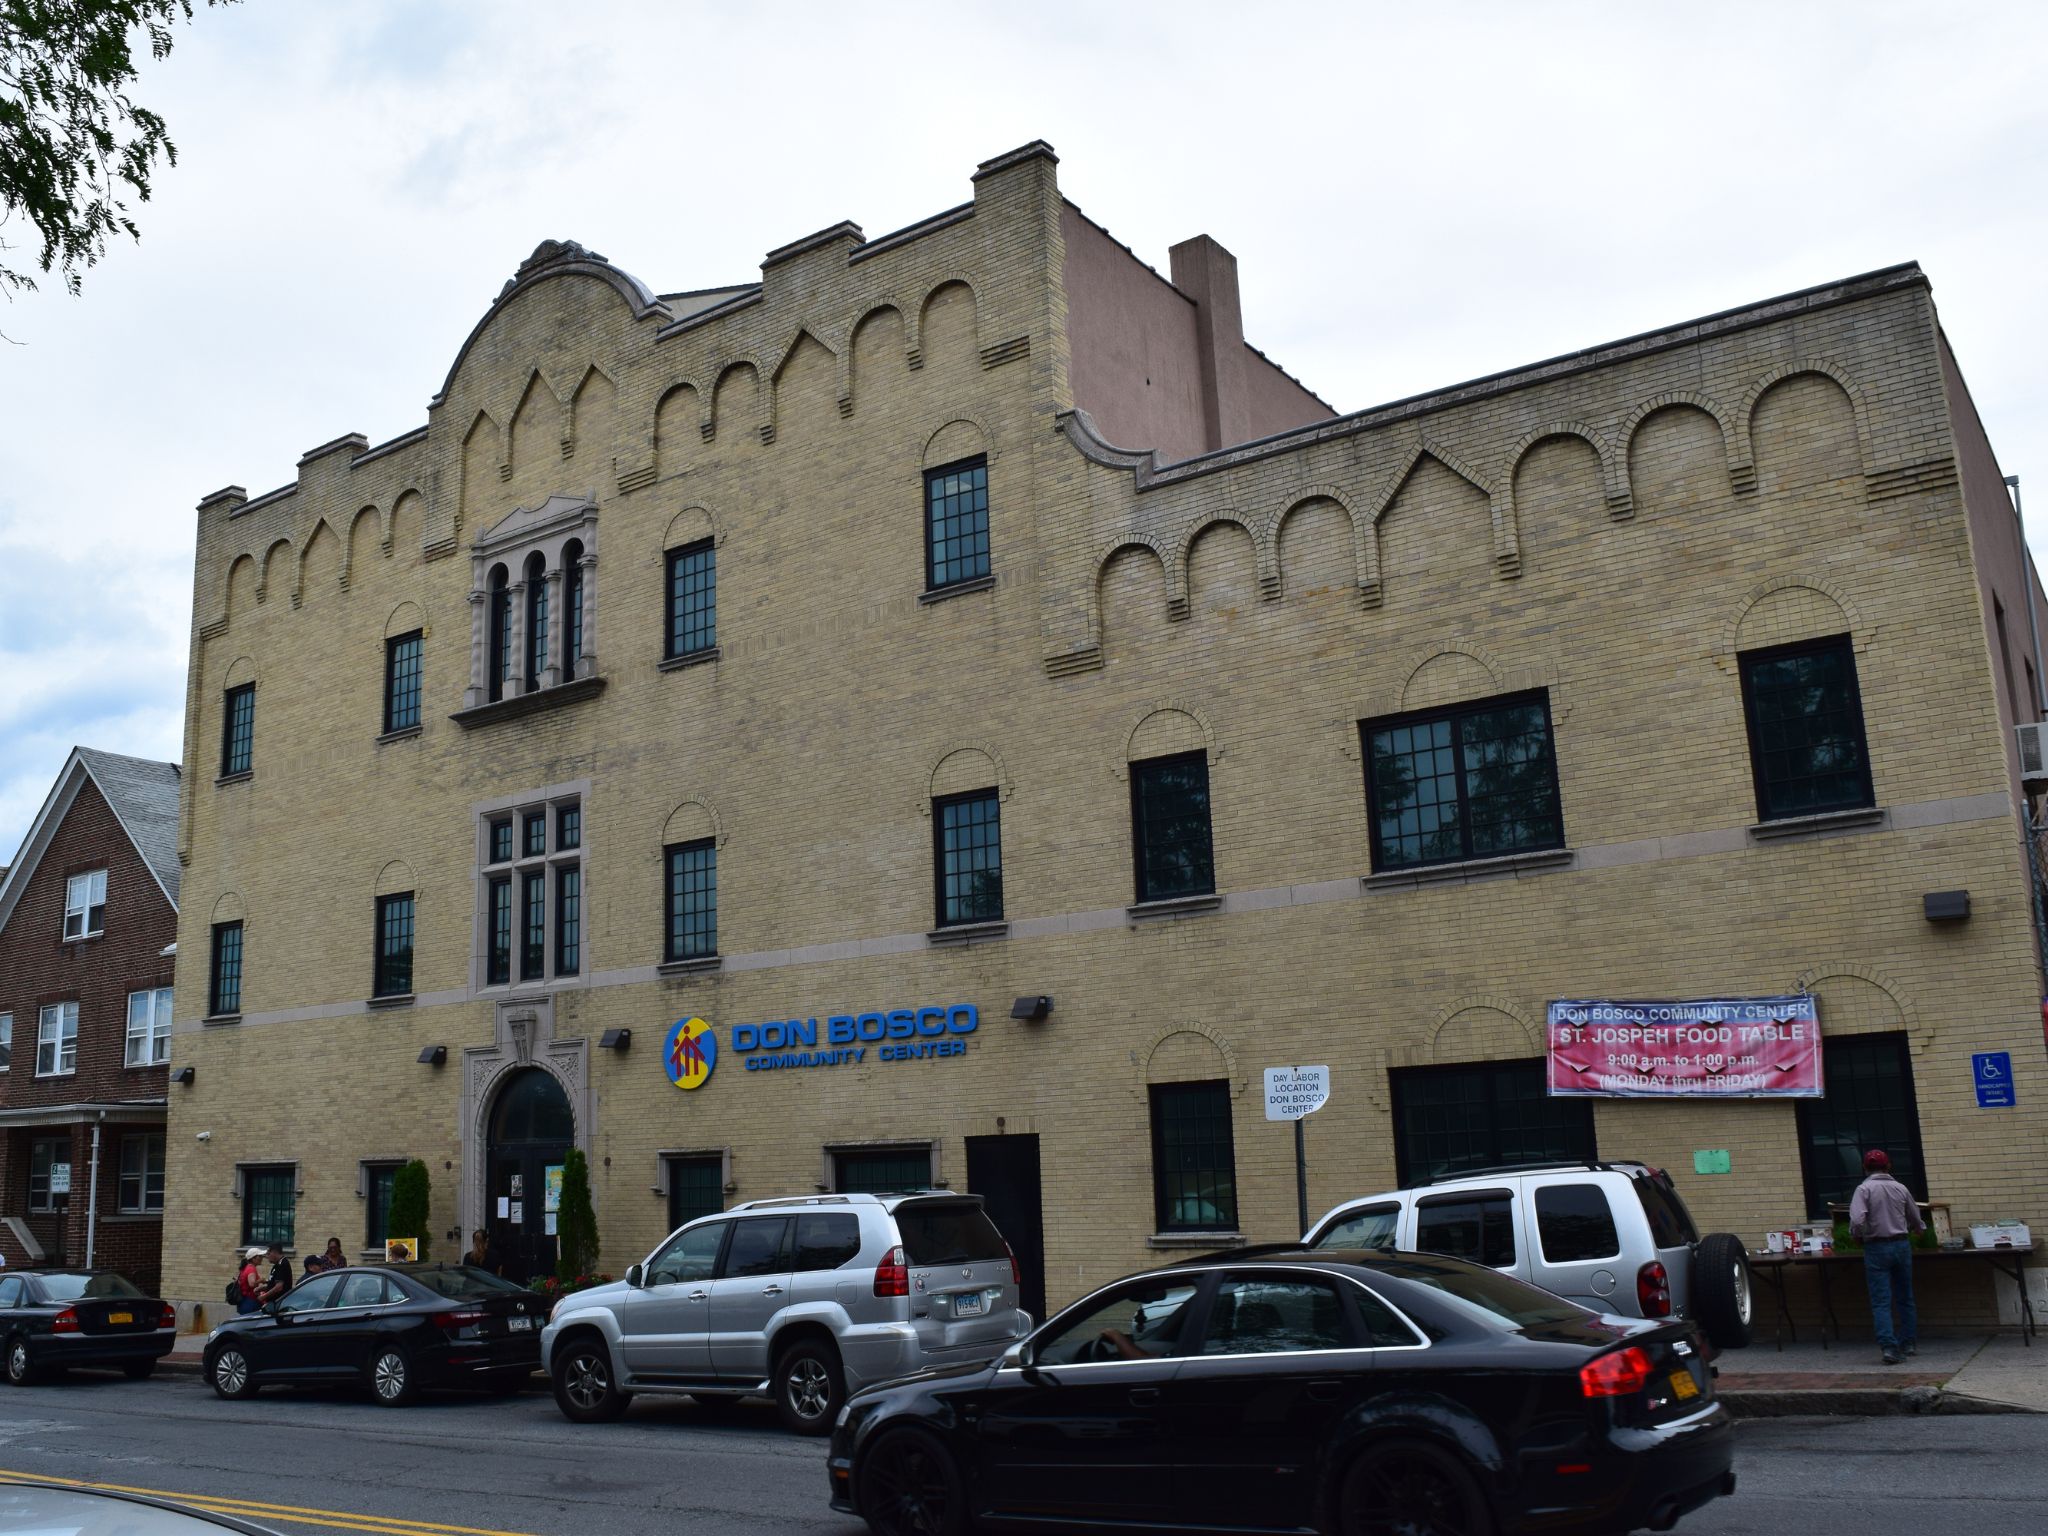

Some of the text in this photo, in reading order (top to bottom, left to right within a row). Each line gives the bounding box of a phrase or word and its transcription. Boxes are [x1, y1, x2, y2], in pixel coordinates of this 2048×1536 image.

[1557, 1003, 1809, 1020] DON BOSCO COMMUNITY CENTER
[732, 1004, 977, 1052] DON BOSCO
[1560, 1024, 1805, 1043] ST. JOSPEH FOOD TABLE
[744, 1039, 966, 1071] COMMUNITY CENTER
[1608, 1054, 1759, 1068] 9:00 a.m. to 1:00 p.m.
[1273, 1073, 1320, 1082] DAY LABOR
[1600, 1074, 1766, 1089] (MONDAY thru FRIDAY)
[1275, 1083, 1319, 1093] LOCATION
[1270, 1094, 1325, 1104] DON BOSCO
[1281, 1105, 1314, 1113] CENTER
